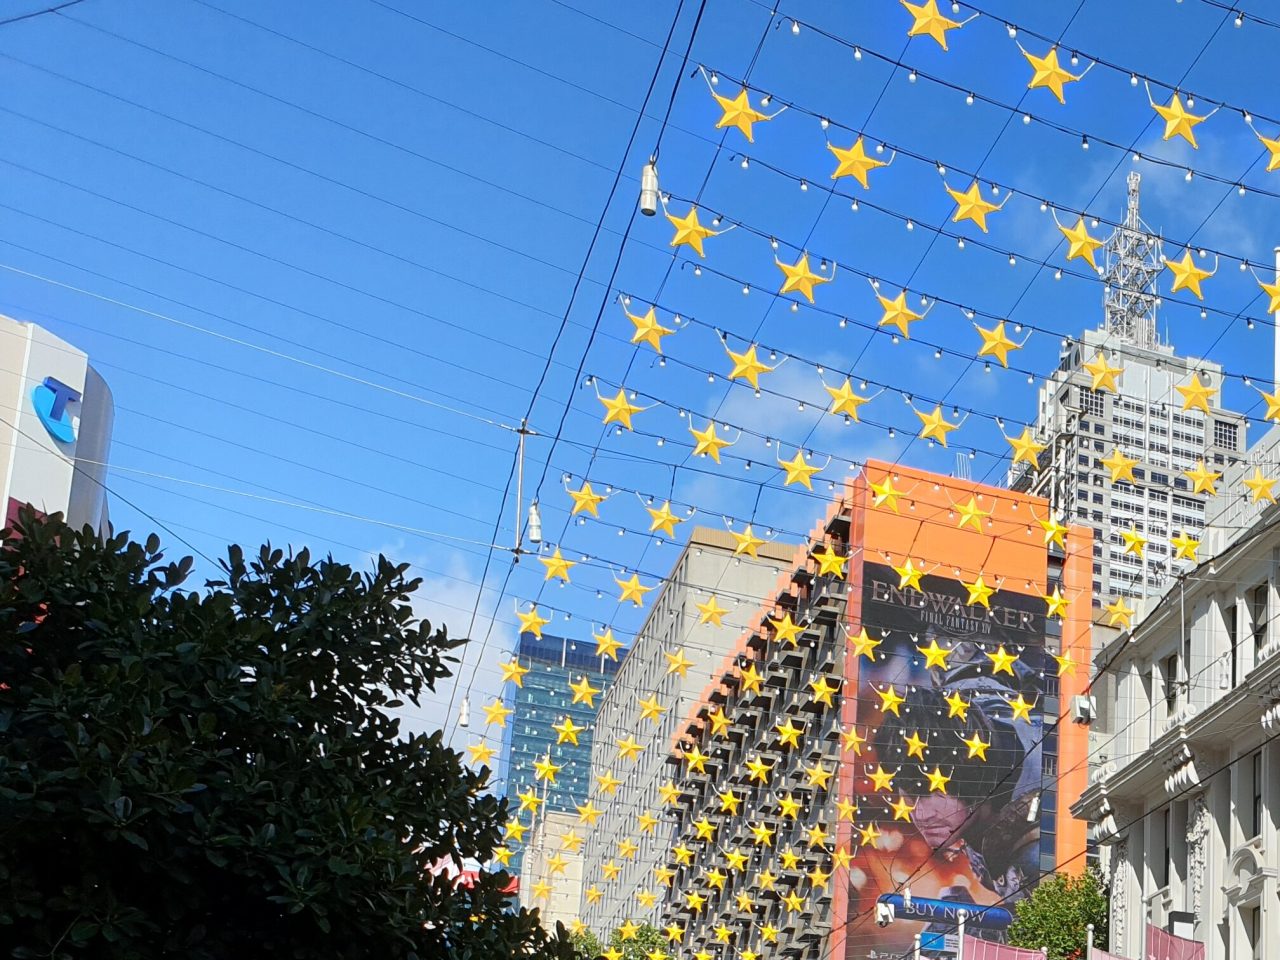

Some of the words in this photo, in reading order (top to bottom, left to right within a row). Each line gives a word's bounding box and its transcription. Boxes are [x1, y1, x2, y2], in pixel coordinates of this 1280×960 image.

[871, 579, 1037, 633] ENDWALKER
[920, 610, 943, 624] FINAL
[946, 615, 980, 633] FANTASY
[905, 902, 937, 917] BUY
[944, 905, 986, 921] NOW
